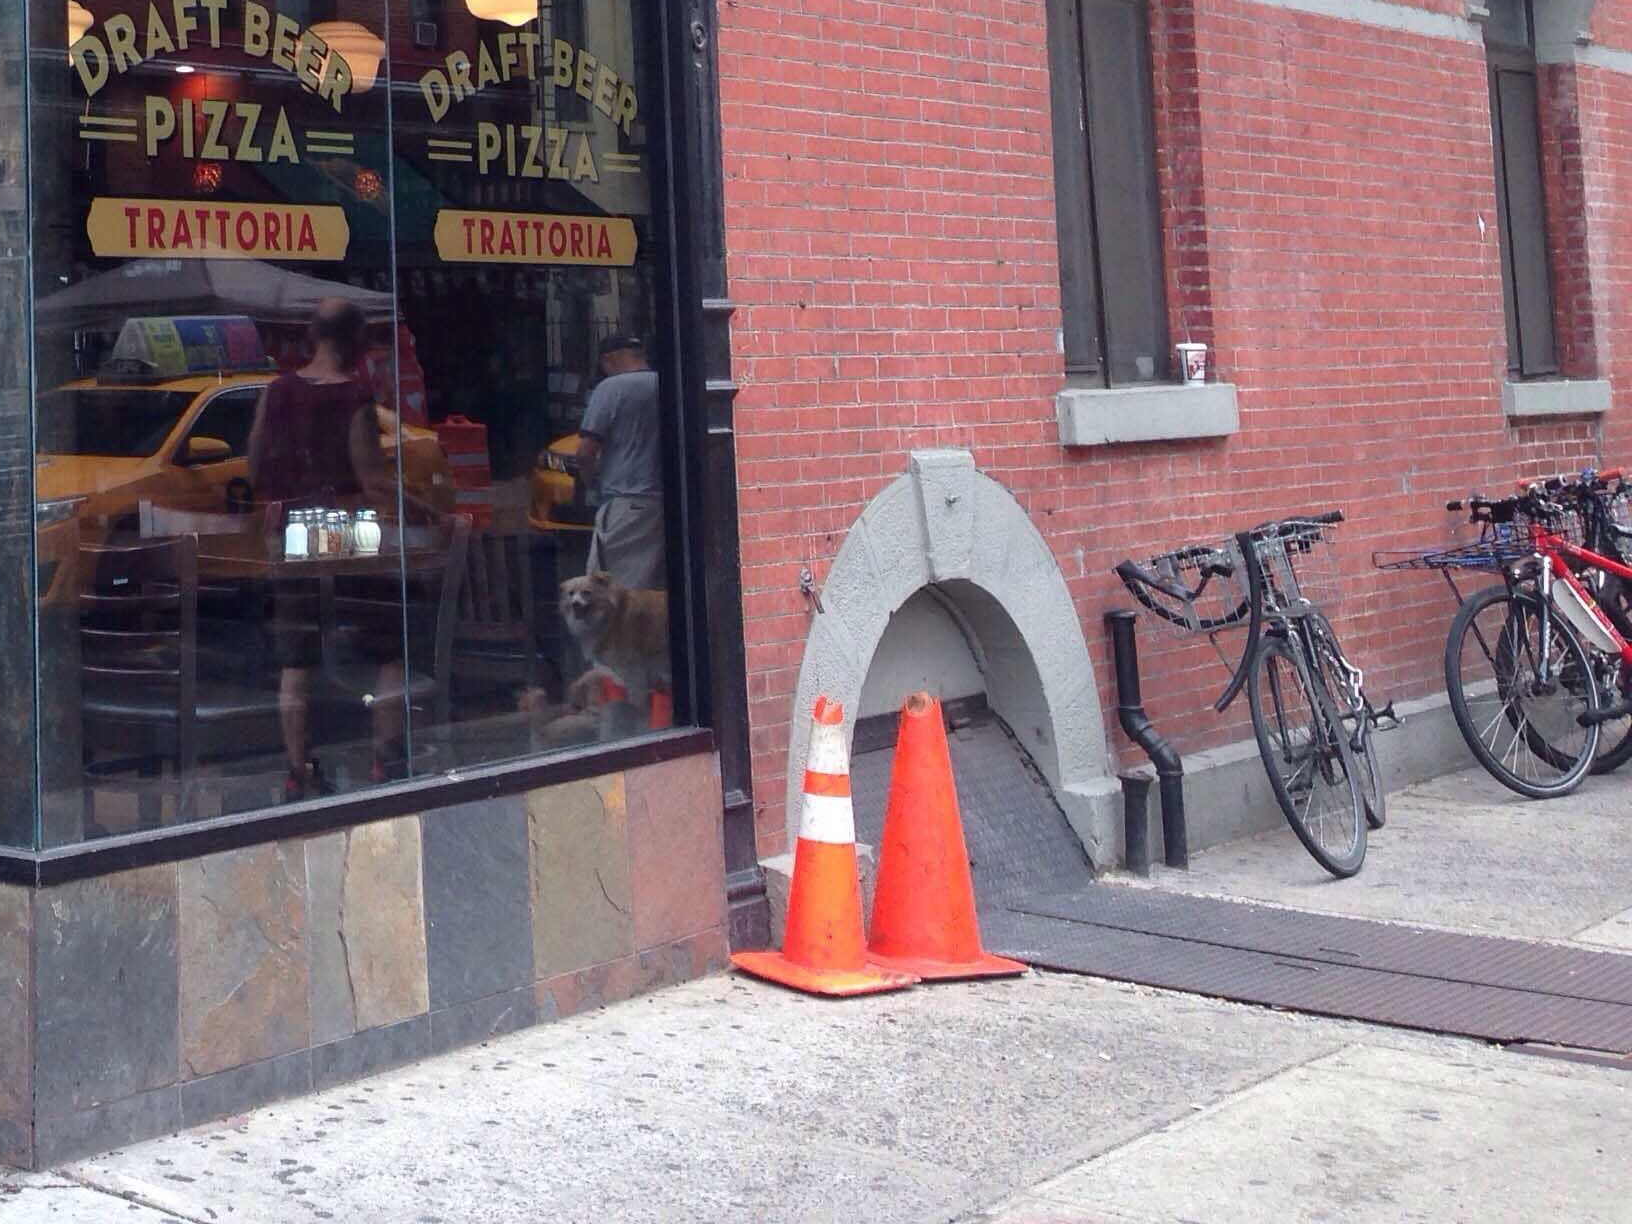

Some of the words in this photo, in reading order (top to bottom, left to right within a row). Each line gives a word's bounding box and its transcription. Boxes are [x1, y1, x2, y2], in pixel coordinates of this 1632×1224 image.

[243, 0, 353, 114] BEER
[419, 32, 540, 123] DRAFT
[552, 38, 639, 137] BEER
[145, 96, 300, 164] PIZZA
[479, 122, 599, 183] PIZZA
[124, 207, 318, 253] TRATTORIA
[462, 218, 612, 259] TRATTORIA
